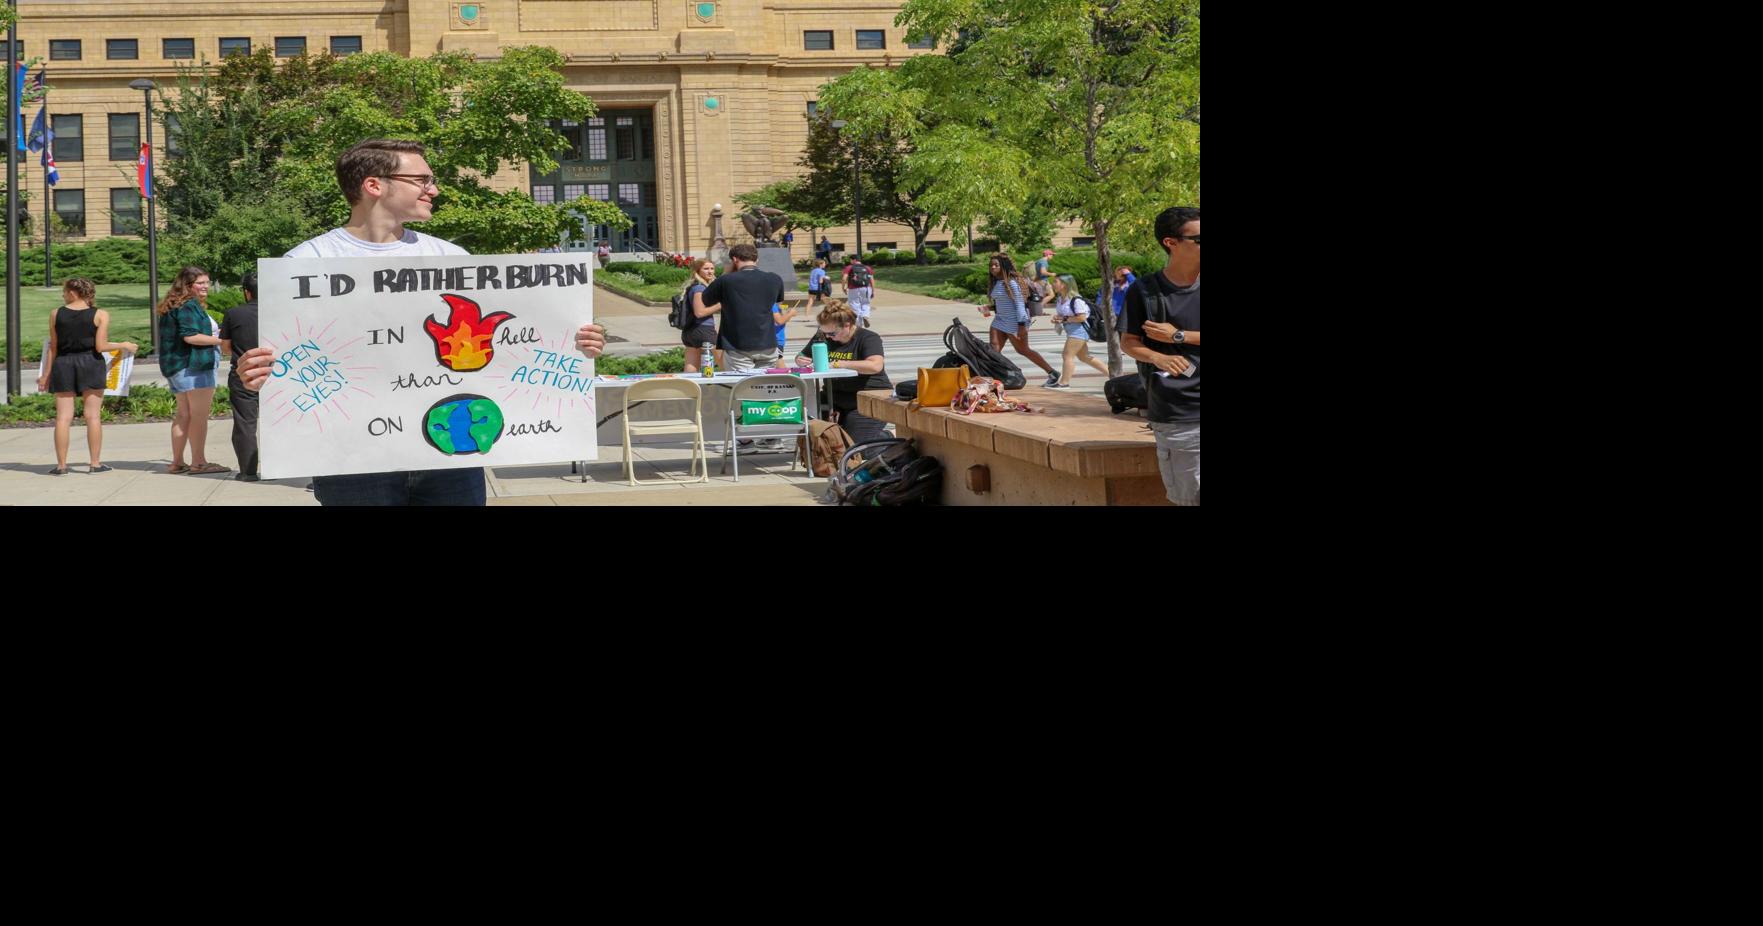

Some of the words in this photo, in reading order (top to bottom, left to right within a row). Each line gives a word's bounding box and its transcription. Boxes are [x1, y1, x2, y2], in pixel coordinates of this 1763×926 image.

[291, 273, 356, 299] I'D
[373, 265, 502, 293] RATHER
[506, 263, 588, 289] BURN
[367, 326, 404, 345] IN
[496, 327, 540, 346] hell
[271, 339, 321, 378] OPEN
[289, 356, 341, 388] YOUR
[533, 349, 583, 374] TAKE
[292, 369, 349, 412] EYES!
[390, 372, 463, 391] than
[511, 365, 594, 396] ACTION!
[367, 415, 403, 436] ON
[505, 419, 563, 437] earth
[747, 407, 766, 417] my
